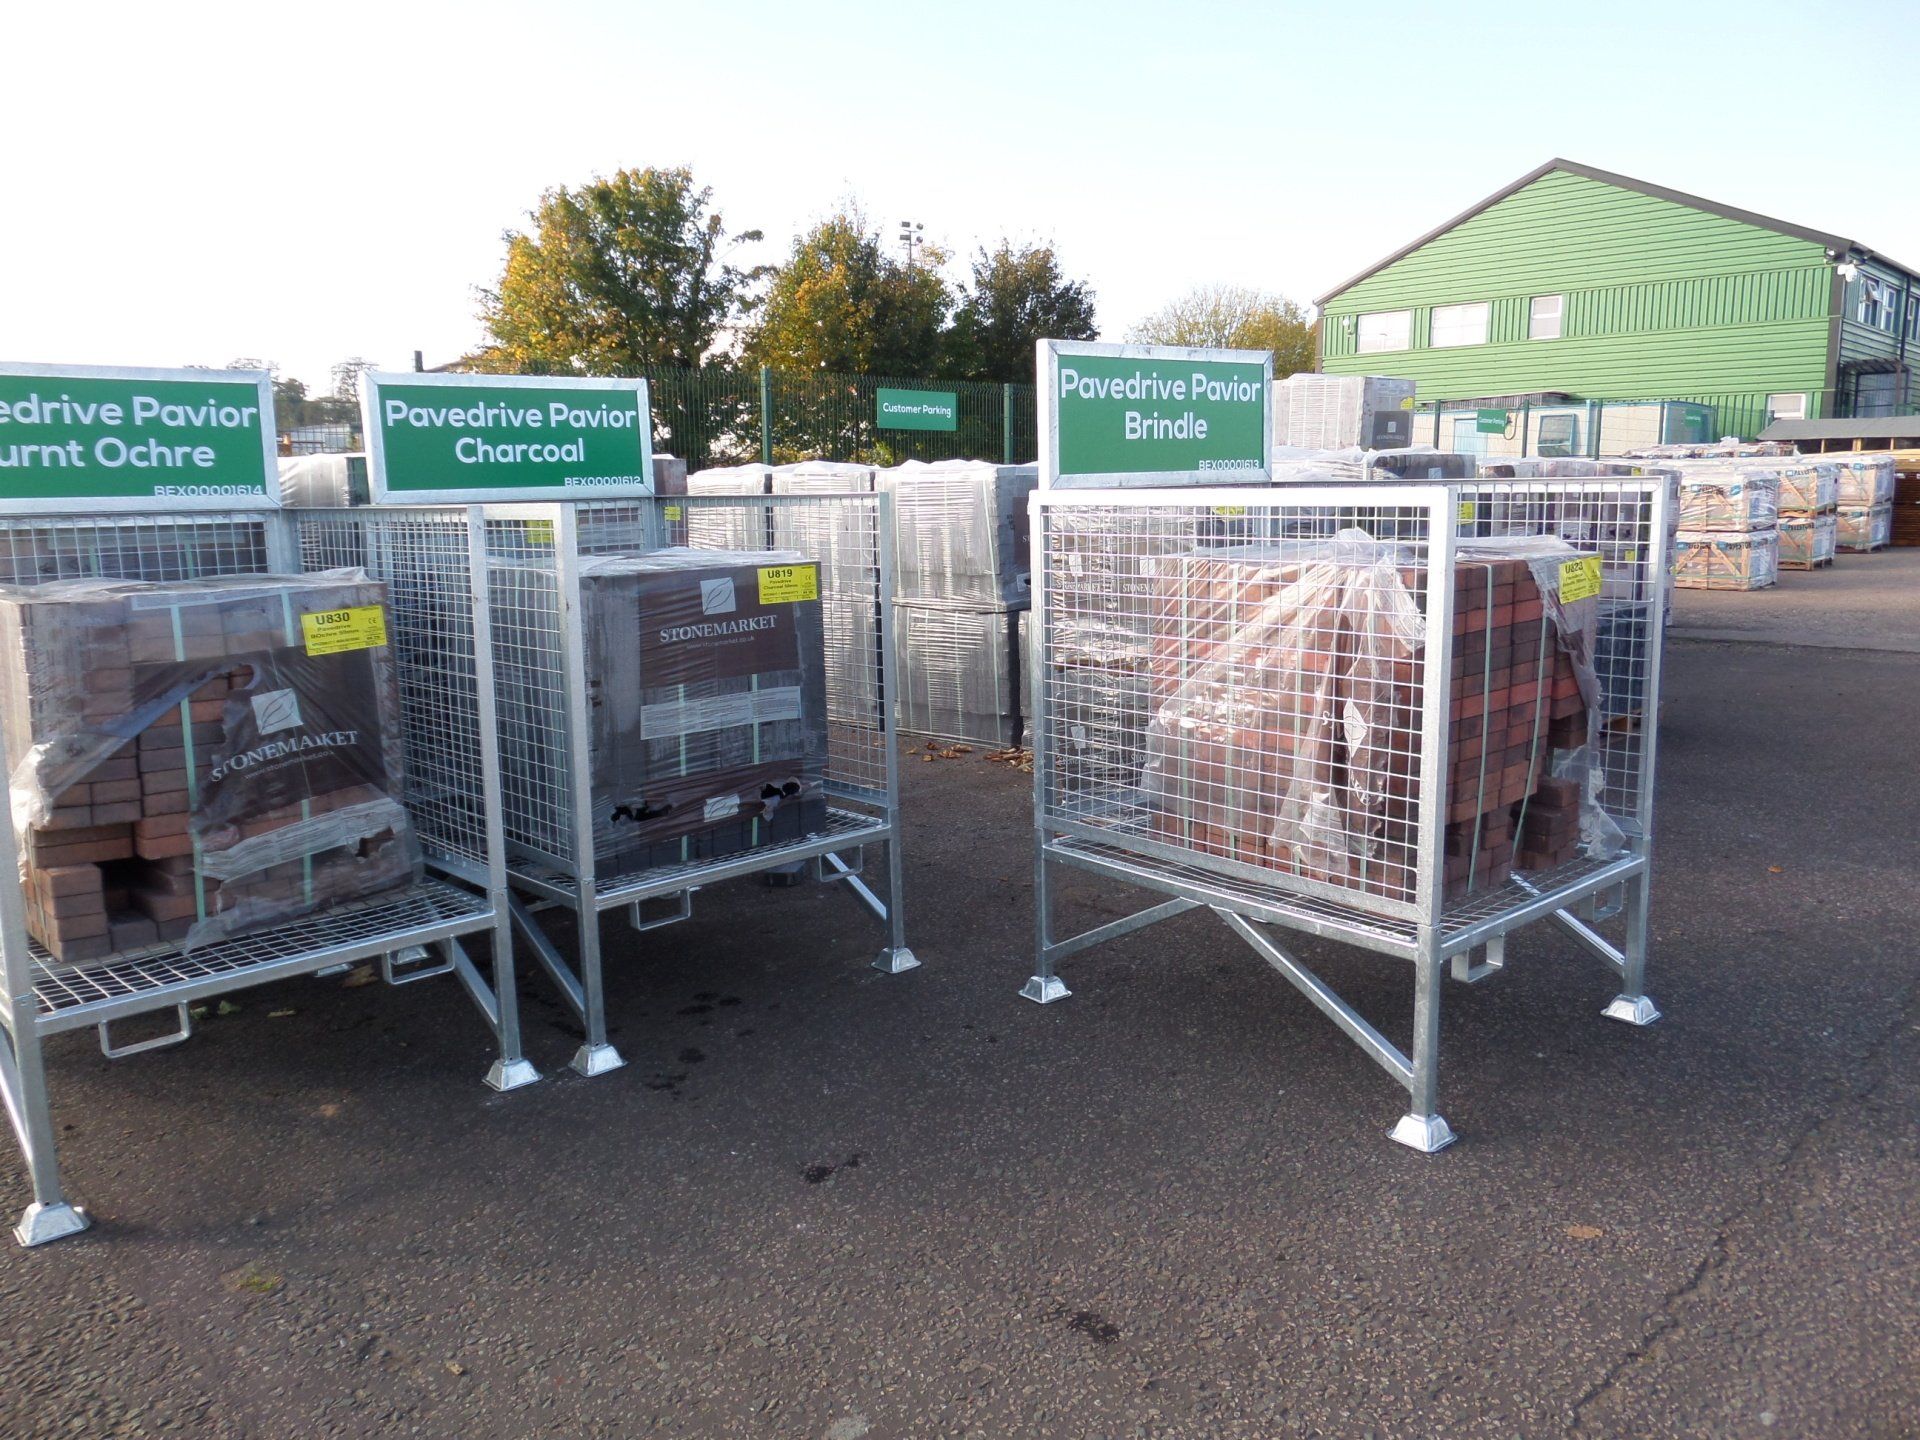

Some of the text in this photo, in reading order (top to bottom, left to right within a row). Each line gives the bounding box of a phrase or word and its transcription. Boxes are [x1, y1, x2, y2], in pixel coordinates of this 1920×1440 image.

[1061, 369, 1262, 402] Pavedrive Pavior
[132, 396, 258, 428] Pavior
[385, 400, 637, 428] Pavedrive Pavior
[882, 402, 952, 418] Customer Parking
[1125, 410, 1208, 440] Brindle
[94, 437, 216, 468] Ochre
[455, 437, 584, 463] Charcoal
[1198, 460, 1260, 471] BEX00001613
[154, 484, 263, 496] BEX00001614
[564, 476, 641, 487] BEX00001612
[767, 568, 793, 578] U819
[315, 611, 350, 625] U830
[659, 615, 777, 642] STONEMARKET
